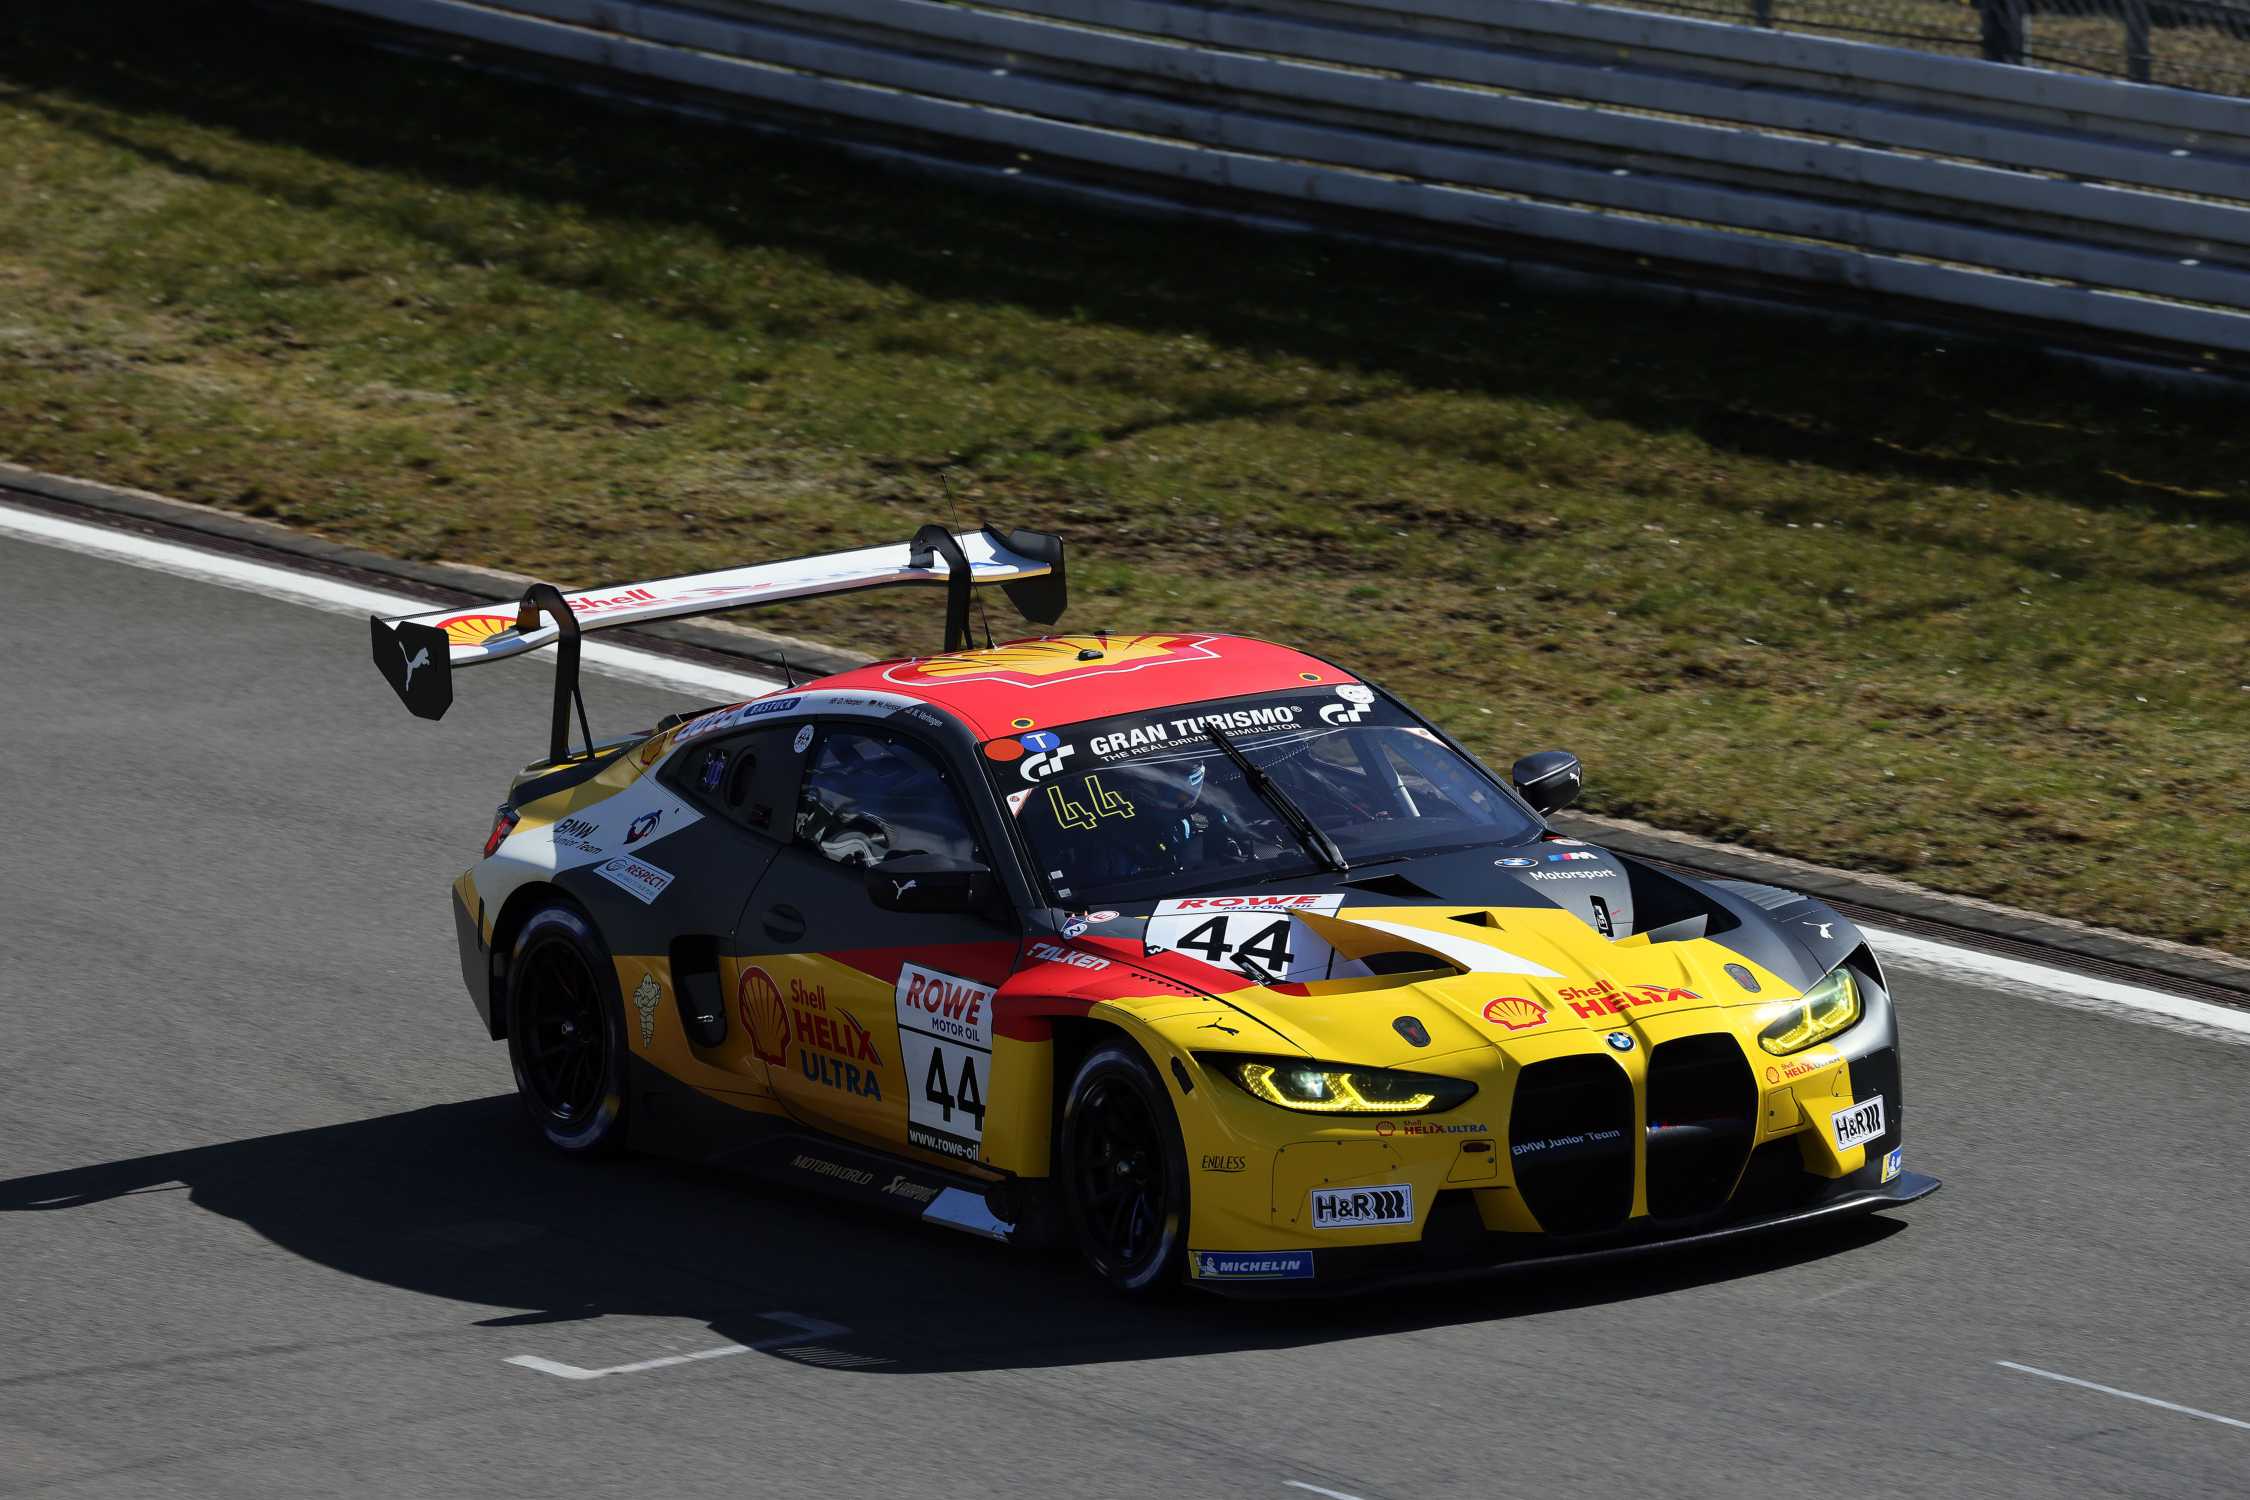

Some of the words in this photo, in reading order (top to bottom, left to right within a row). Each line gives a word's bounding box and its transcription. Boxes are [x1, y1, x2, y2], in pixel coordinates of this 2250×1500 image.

[567, 587, 657, 611] Shell
[1089, 728, 1168, 756] GRAN
[1101, 750, 1130, 763] THE
[1132, 743, 1167, 755] REAL
[1225, 723, 1303, 738] SIMULATOR
[1046, 774, 1136, 830] 44
[553, 818, 600, 839] BMW
[1528, 868, 1617, 881] Motorsport
[1175, 895, 1323, 910] ROWE
[1026, 942, 1112, 971] FALKEN
[1176, 914, 1295, 973] 44
[790, 978, 827, 1010] Shell
[905, 971, 987, 1026] ROWE
[1557, 979, 1616, 1001] Shell
[1567, 985, 1702, 1020] HELIX
[792, 1007, 882, 1067] HELIX
[931, 1016, 965, 1039] MOTOR
[965, 1026, 980, 1043] OIL
[799, 1049, 883, 1102] ULTRA
[925, 1046, 986, 1132] 44
[1446, 1123, 1488, 1134] ULTRA
[1511, 1141, 1547, 1156] BMW
[1548, 1133, 1585, 1149] Junior
[1585, 1127, 1621, 1141] Team
[1835, 1110, 1867, 1144] H&R
[1201, 1154, 1247, 1172] ENDLESS
[1315, 1193, 1373, 1222] H&R
[1219, 1259, 1301, 1273] MICHELIN
